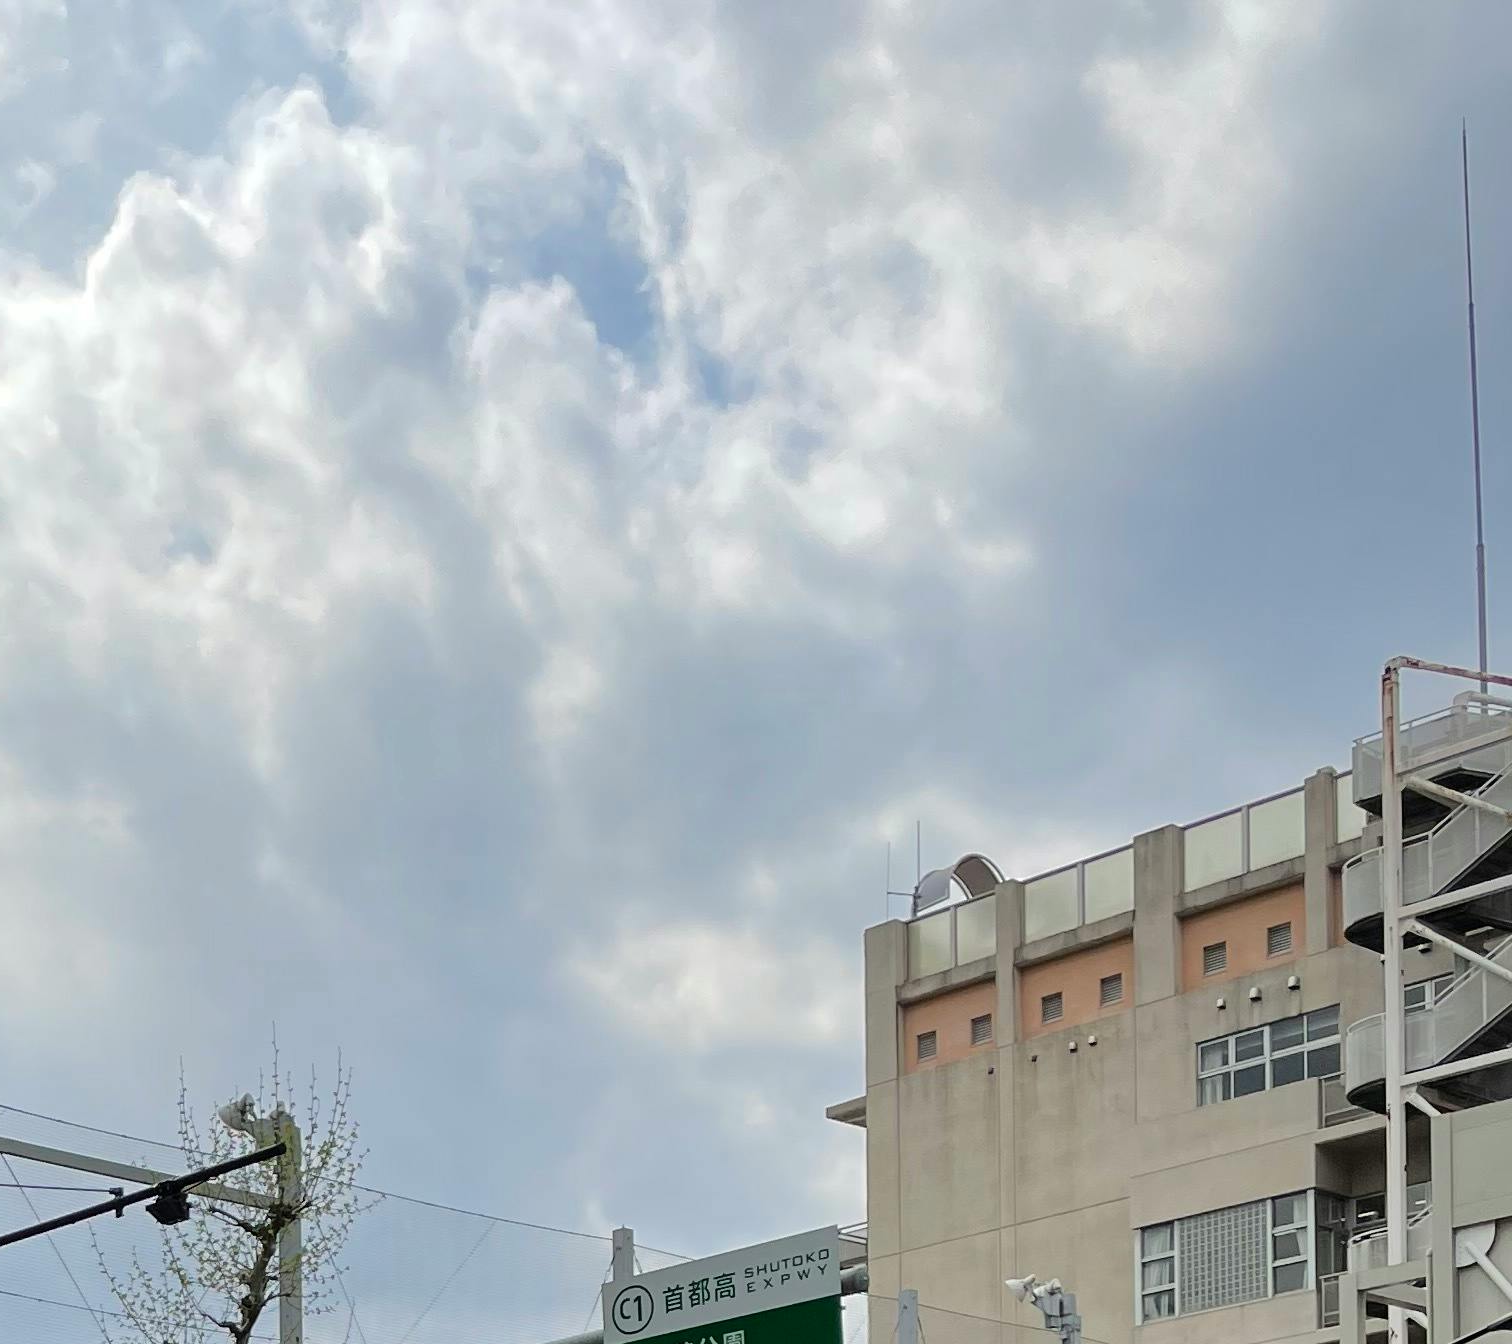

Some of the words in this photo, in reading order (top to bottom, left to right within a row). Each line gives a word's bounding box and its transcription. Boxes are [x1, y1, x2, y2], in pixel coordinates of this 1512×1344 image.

[744, 1248, 830, 1279] SHUTOKO
[747, 1265, 828, 1293] EXPWY
[619, 1295, 643, 1322] C1
[662, 1272, 736, 1313] 首都高
